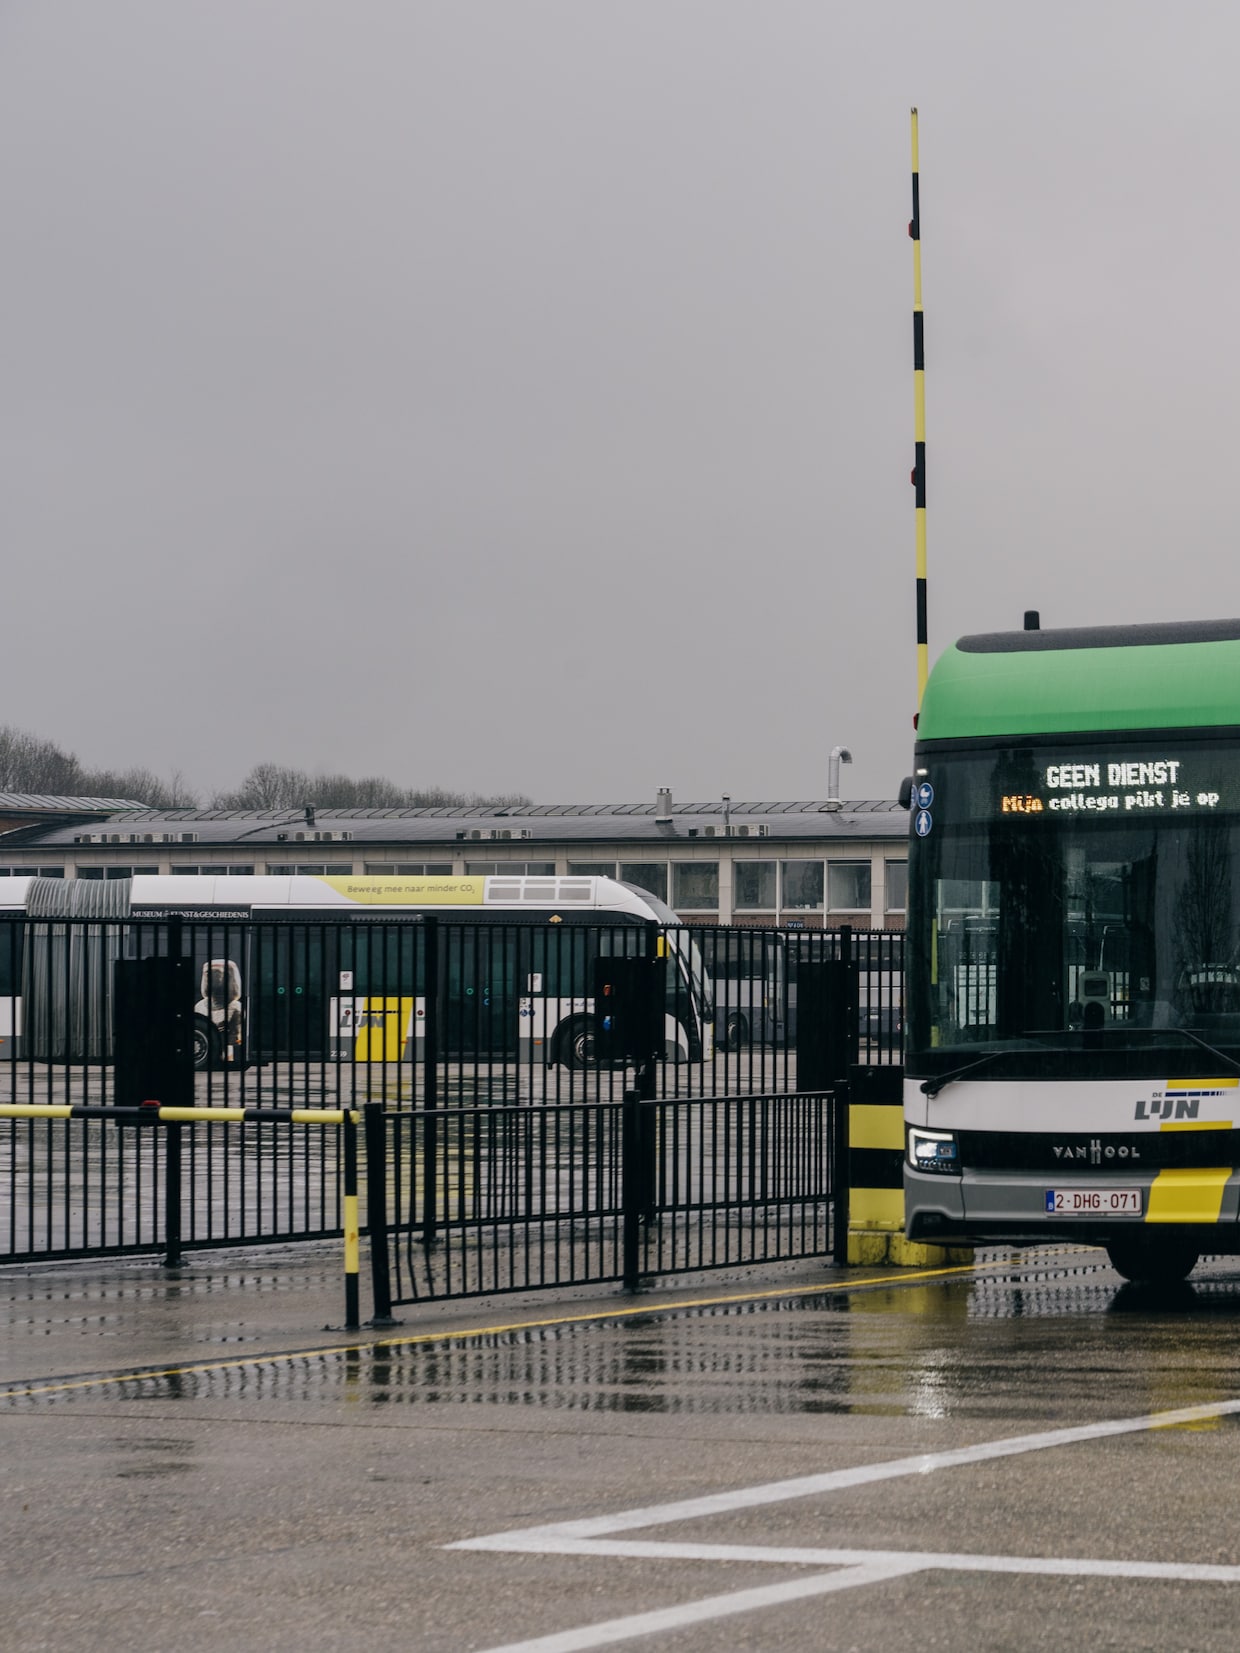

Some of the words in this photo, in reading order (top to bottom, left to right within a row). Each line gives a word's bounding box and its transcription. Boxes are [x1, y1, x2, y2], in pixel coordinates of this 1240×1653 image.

[1046, 764, 1100, 788] GEEN
[1108, 761, 1180, 786] DIENST
[1002, 795, 1044, 813] Mijn
[1048, 793, 1119, 811] collega
[1125, 791, 1165, 810] pikt
[1171, 790, 1191, 809] je
[1197, 792, 1220, 809] op
[347, 885, 383, 894] Beweeg
[427, 884, 457, 892] minder
[132, 910, 163, 918] MUSEUM
[1134, 1100, 1200, 1120] LIJN
